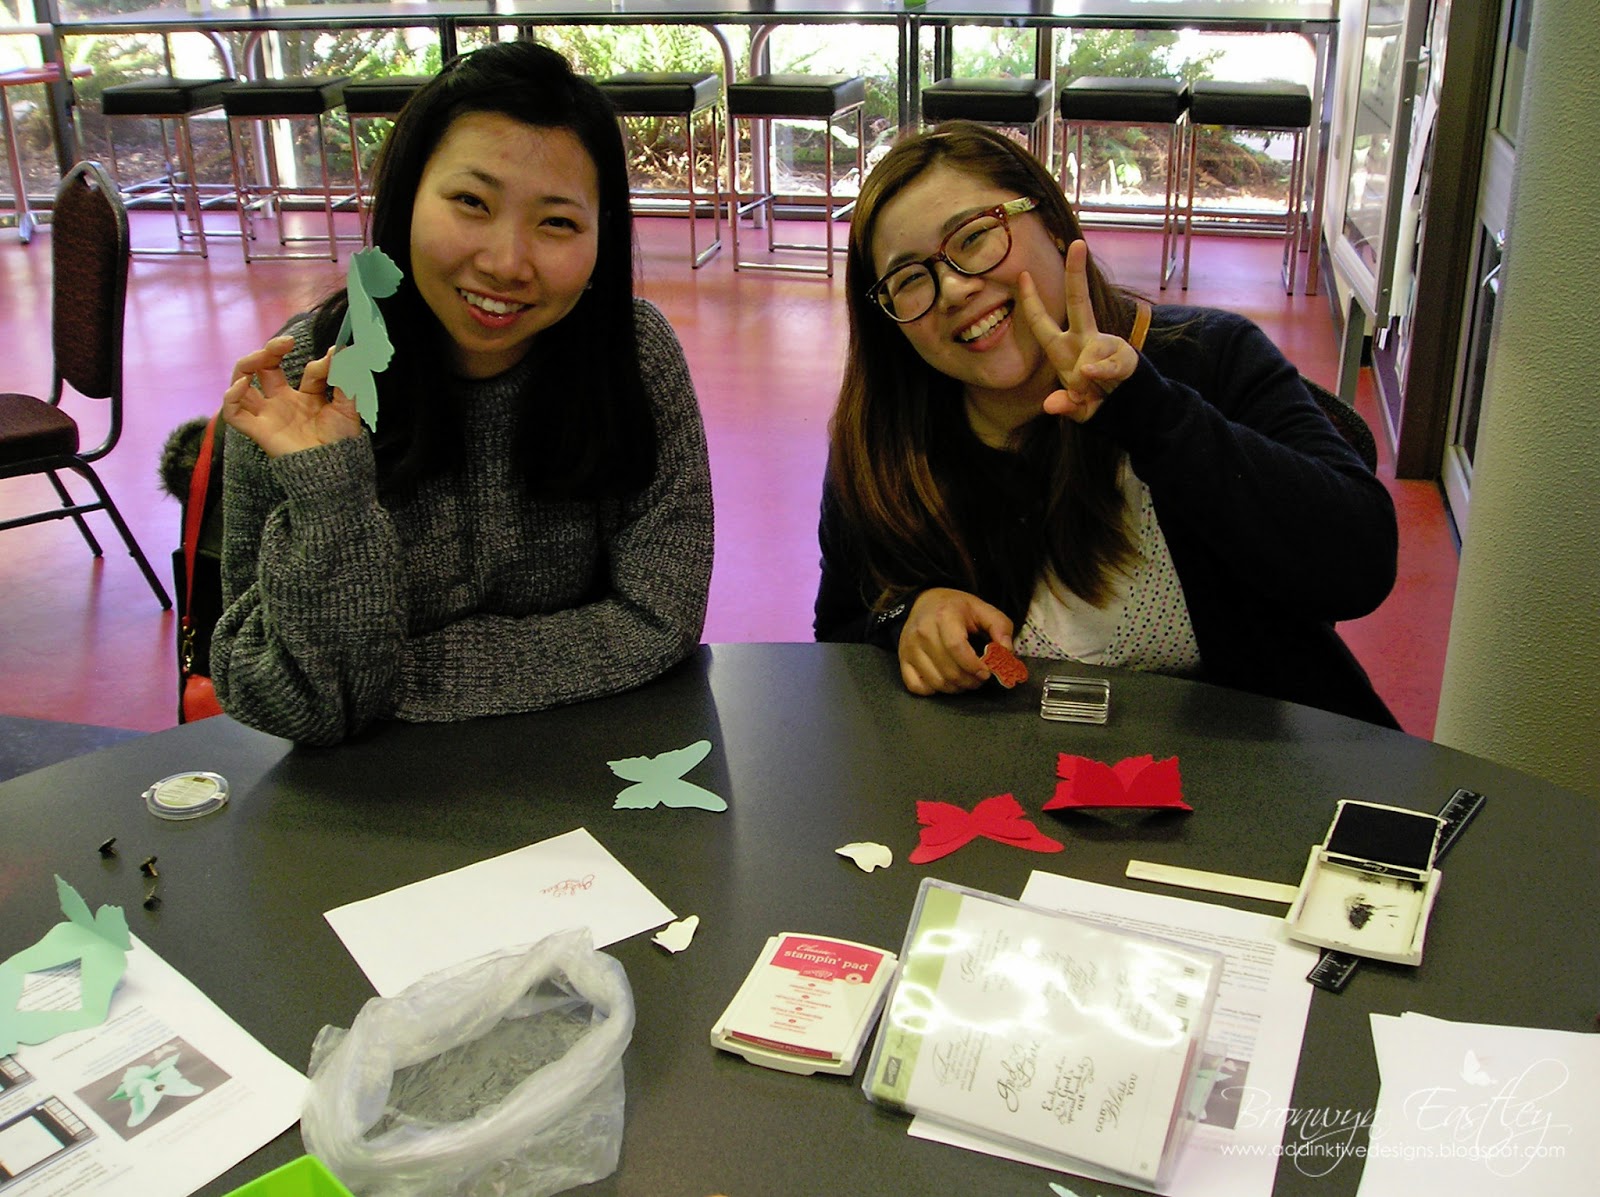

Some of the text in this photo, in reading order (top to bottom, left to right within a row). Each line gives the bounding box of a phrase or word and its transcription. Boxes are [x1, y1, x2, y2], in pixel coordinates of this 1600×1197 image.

[784, 950, 869, 972] stampin' pad
[1017, 1040, 1041, 1088] Love
[997, 1060, 1020, 1113] God
[1057, 1069, 1074, 1098] God's
[1126, 1072, 1139, 1096] YOU
[1041, 1089, 1057, 1112] Each
[1104, 1078, 1128, 1129] Bless
[1095, 1107, 1107, 1133] GOD
